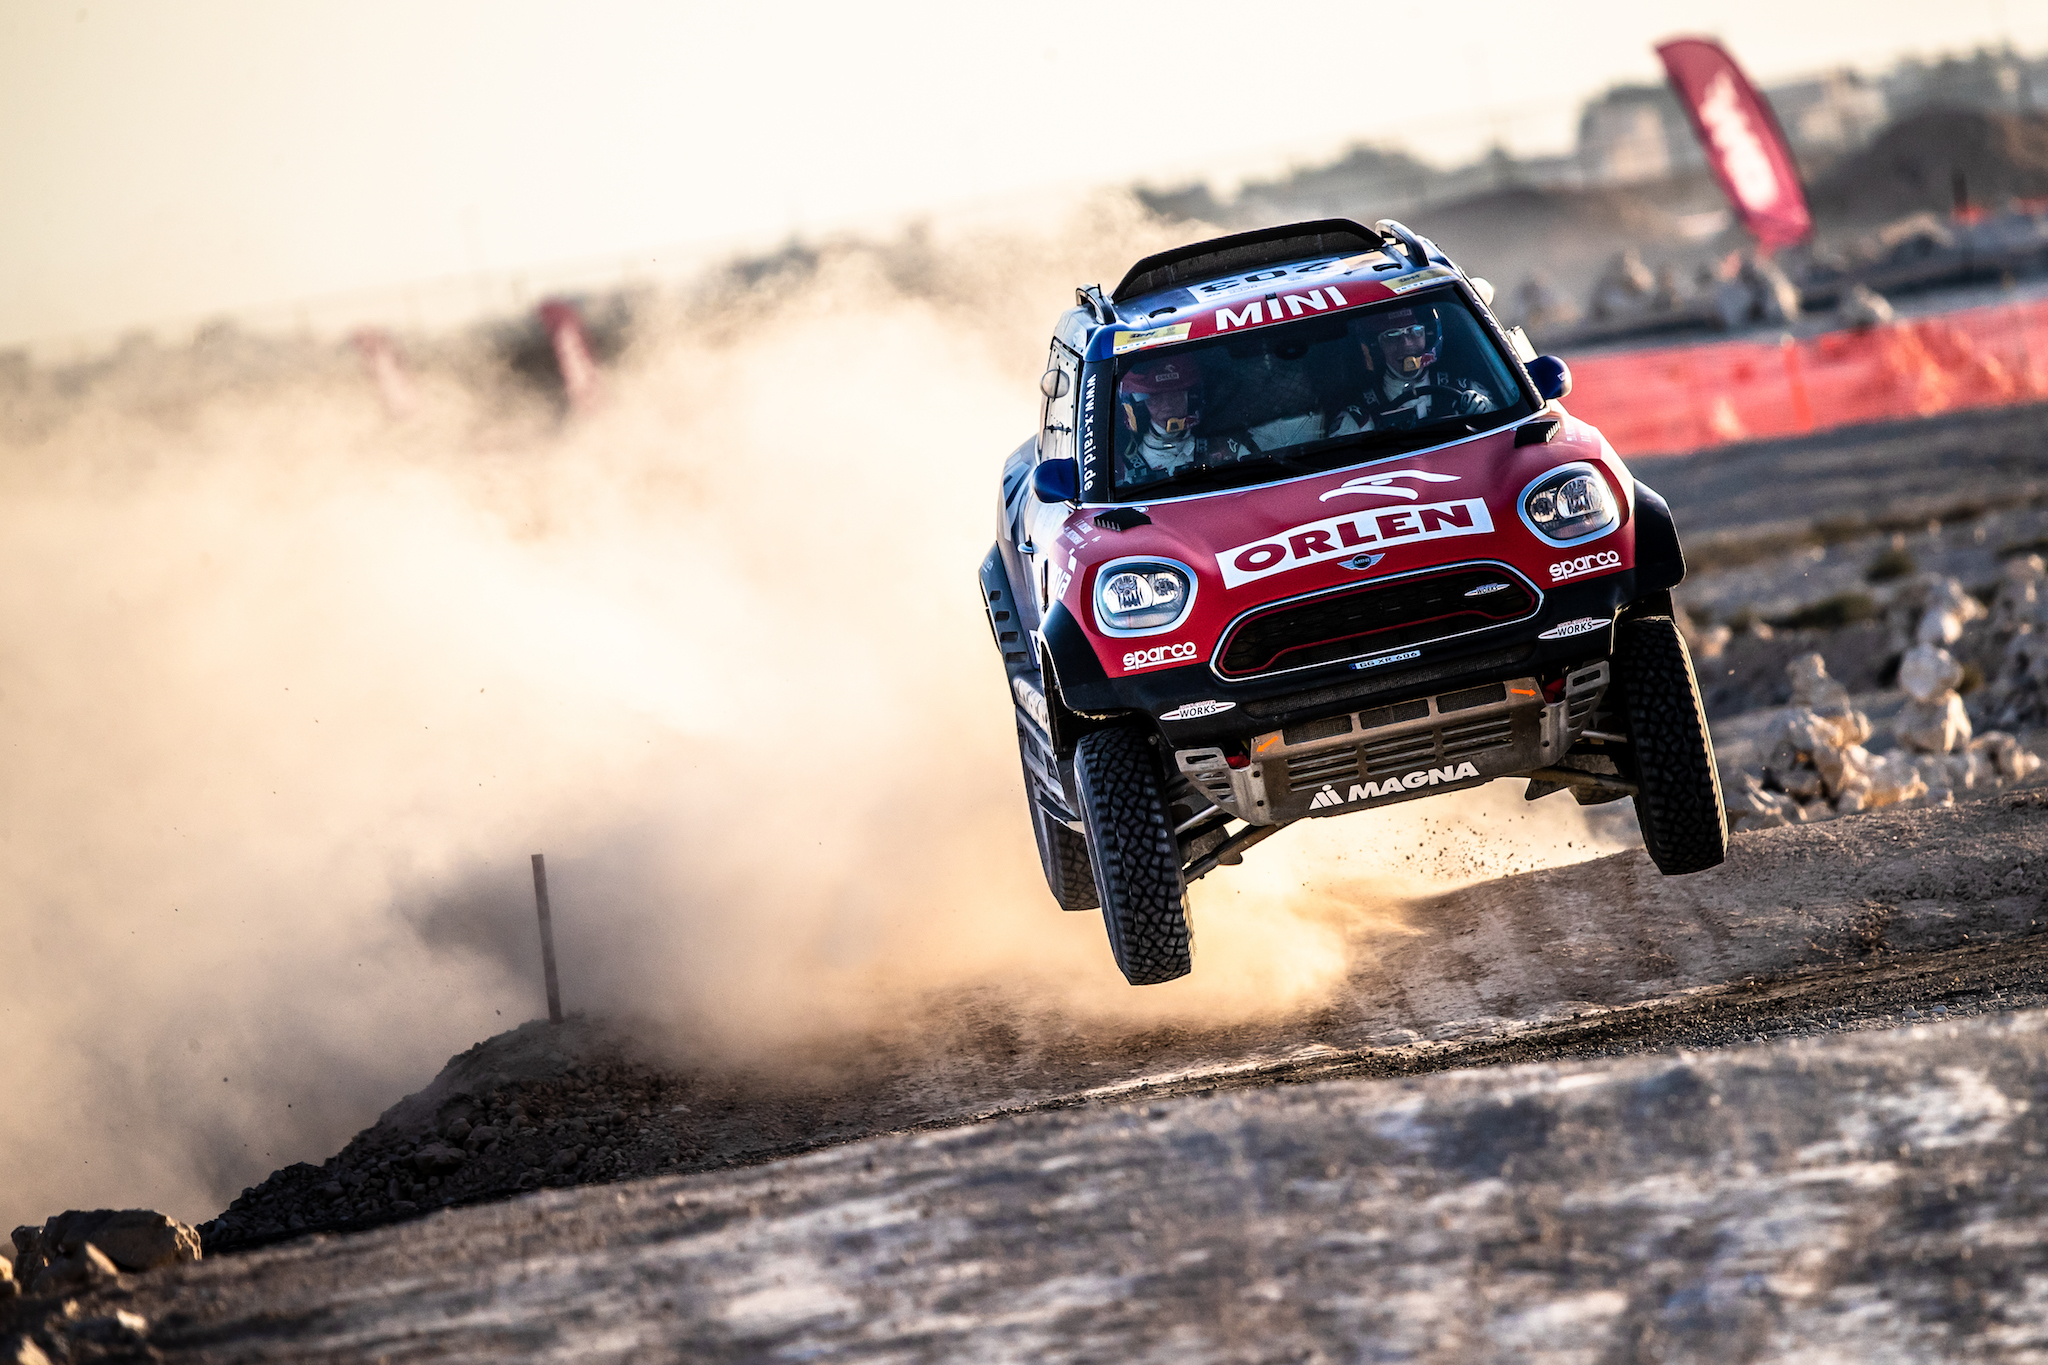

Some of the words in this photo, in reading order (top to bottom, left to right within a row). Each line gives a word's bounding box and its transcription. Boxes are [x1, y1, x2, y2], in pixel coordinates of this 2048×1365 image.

[1215, 286, 1348, 331] MINI
[1084, 373, 1097, 491] www.x-raid.de
[1234, 504, 1474, 572] ORLEN
[1549, 550, 1621, 581] sparco
[1557, 621, 1593, 637] WORKS
[1123, 641, 1197, 671] sparco
[1180, 704, 1216, 718] WORKS
[1348, 761, 1480, 803] MAGNA
